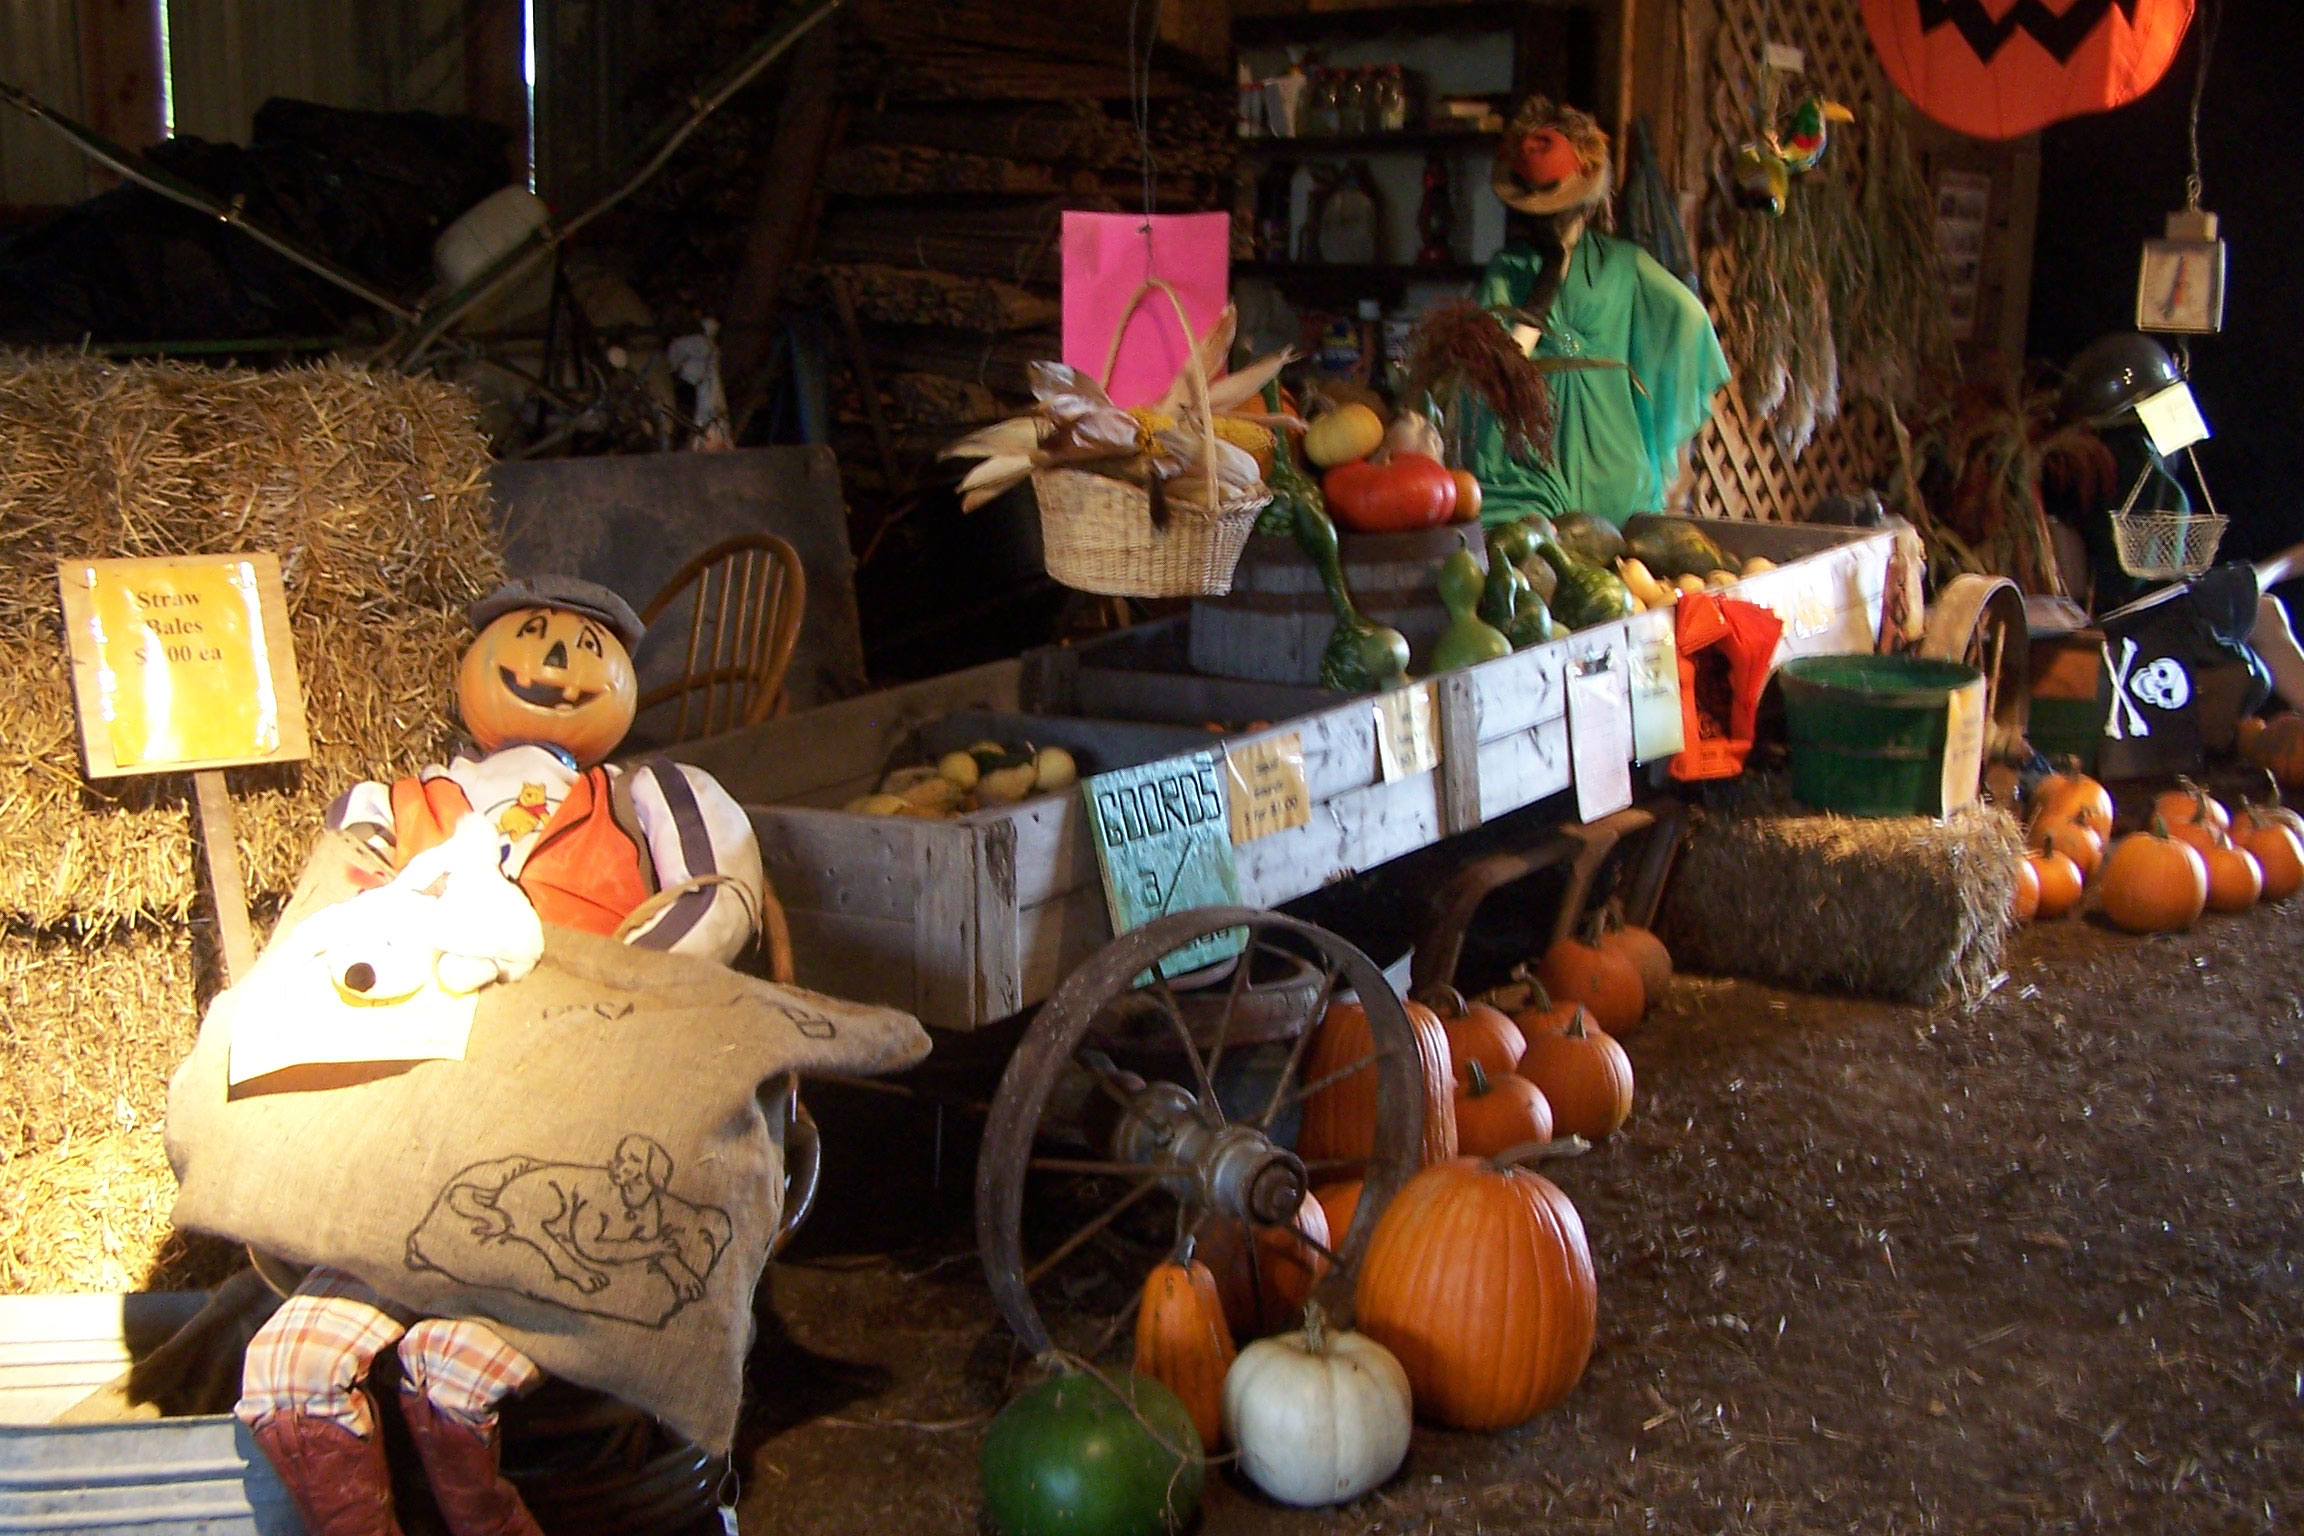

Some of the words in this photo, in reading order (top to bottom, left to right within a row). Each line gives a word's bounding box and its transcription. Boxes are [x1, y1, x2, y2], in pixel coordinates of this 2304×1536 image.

[136, 591, 201, 609] Straw
[145, 618, 204, 636] Bales
[199, 647, 223, 661] ea
